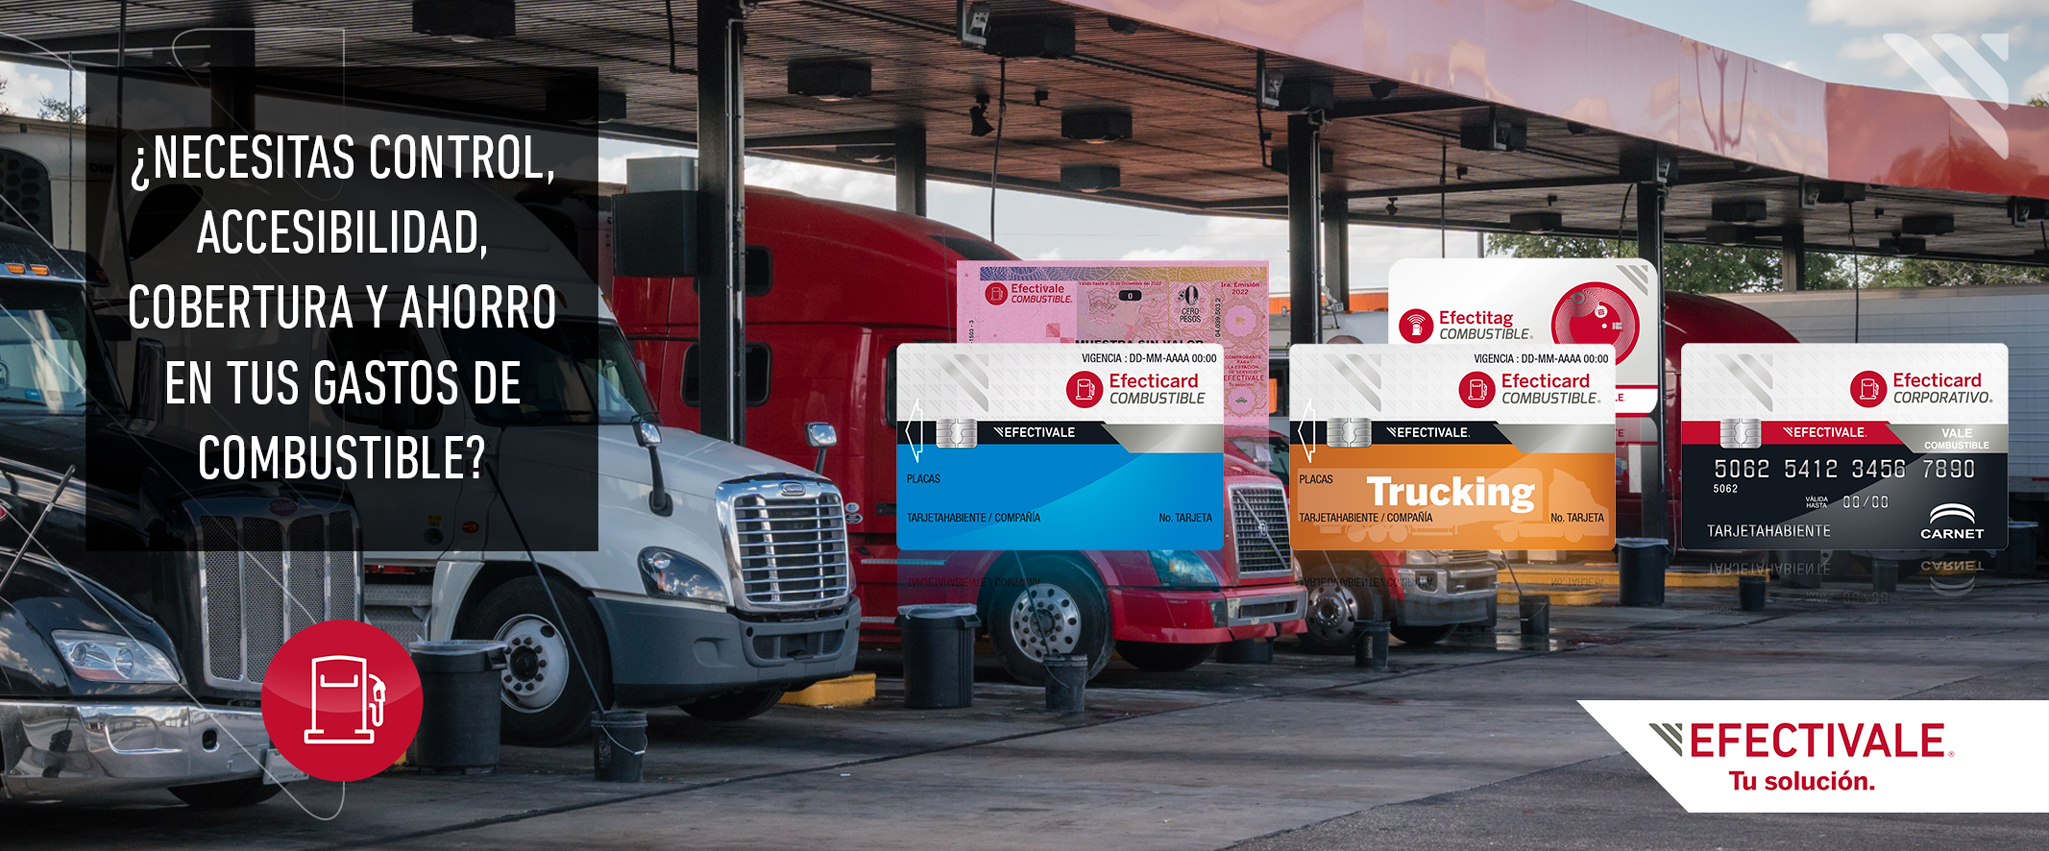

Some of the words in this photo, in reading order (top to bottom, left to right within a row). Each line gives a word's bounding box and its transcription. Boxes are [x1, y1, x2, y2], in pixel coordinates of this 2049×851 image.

[1011, 283, 1064, 294] Efectivale
[1011, 295, 1070, 304] COMBUSTIBLE
[1440, 310, 1514, 328] Efectitag
[1440, 328, 1530, 340] COMBUSTIBLE
[1082, 354, 1122, 363] VIGENCIA
[1129, 354, 1190, 363] DD-MM-AAAA
[1191, 354, 1217, 363] 00:00
[1474, 354, 1514, 363] VIGENCIA
[1521, 354, 1582, 363] DD-MM-AAAA
[1583, 354, 1609, 363] 00:00
[1110, 373, 1199, 388] Efecticard
[1502, 374, 1590, 388] Efecticard
[1894, 372, 1982, 388] Efecticard
[1110, 392, 1206, 405] COMBUSTIBLE
[1502, 392, 1597, 404] COMBUSTIBLE
[1894, 392, 1989, 404] CORPORATIVO
[1004, 427, 1076, 438] EFECTIVALE
[1397, 427, 1468, 438] EFECTIVALE
[1794, 427, 1865, 438] EFECTIVALE
[1941, 428, 1972, 438] VALE
[1924, 441, 1989, 450] COMBUSTIBLE
[1714, 459, 1770, 478] 5062
[1784, 459, 1838, 478] 5412
[1852, 459, 1906, 478] 3456
[1923, 459, 1975, 478] 7890
[907, 474, 941, 484] PLACAS
[1299, 474, 1333, 484] PLACAS
[1366, 476, 1536, 513] Trucking
[1713, 484, 1738, 493] 5062
[1842, 495, 1889, 508] 00/00
[907, 512, 986, 522] TARJETAHABIENTE
[995, 510, 1041, 522] COMPAÑÍA
[1159, 512, 1173, 522] No.
[1175, 512, 1212, 522] TARJETA
[1299, 513, 1378, 523] TARJETAHABIENTE
[1387, 511, 1433, 523] COMPAÑÍA
[1550, 513, 1565, 523] No.
[1567, 513, 1604, 523] TARJETA
[1707, 524, 1831, 537] TARJETAHABIENTE
[1920, 528, 1984, 540] CARNET
